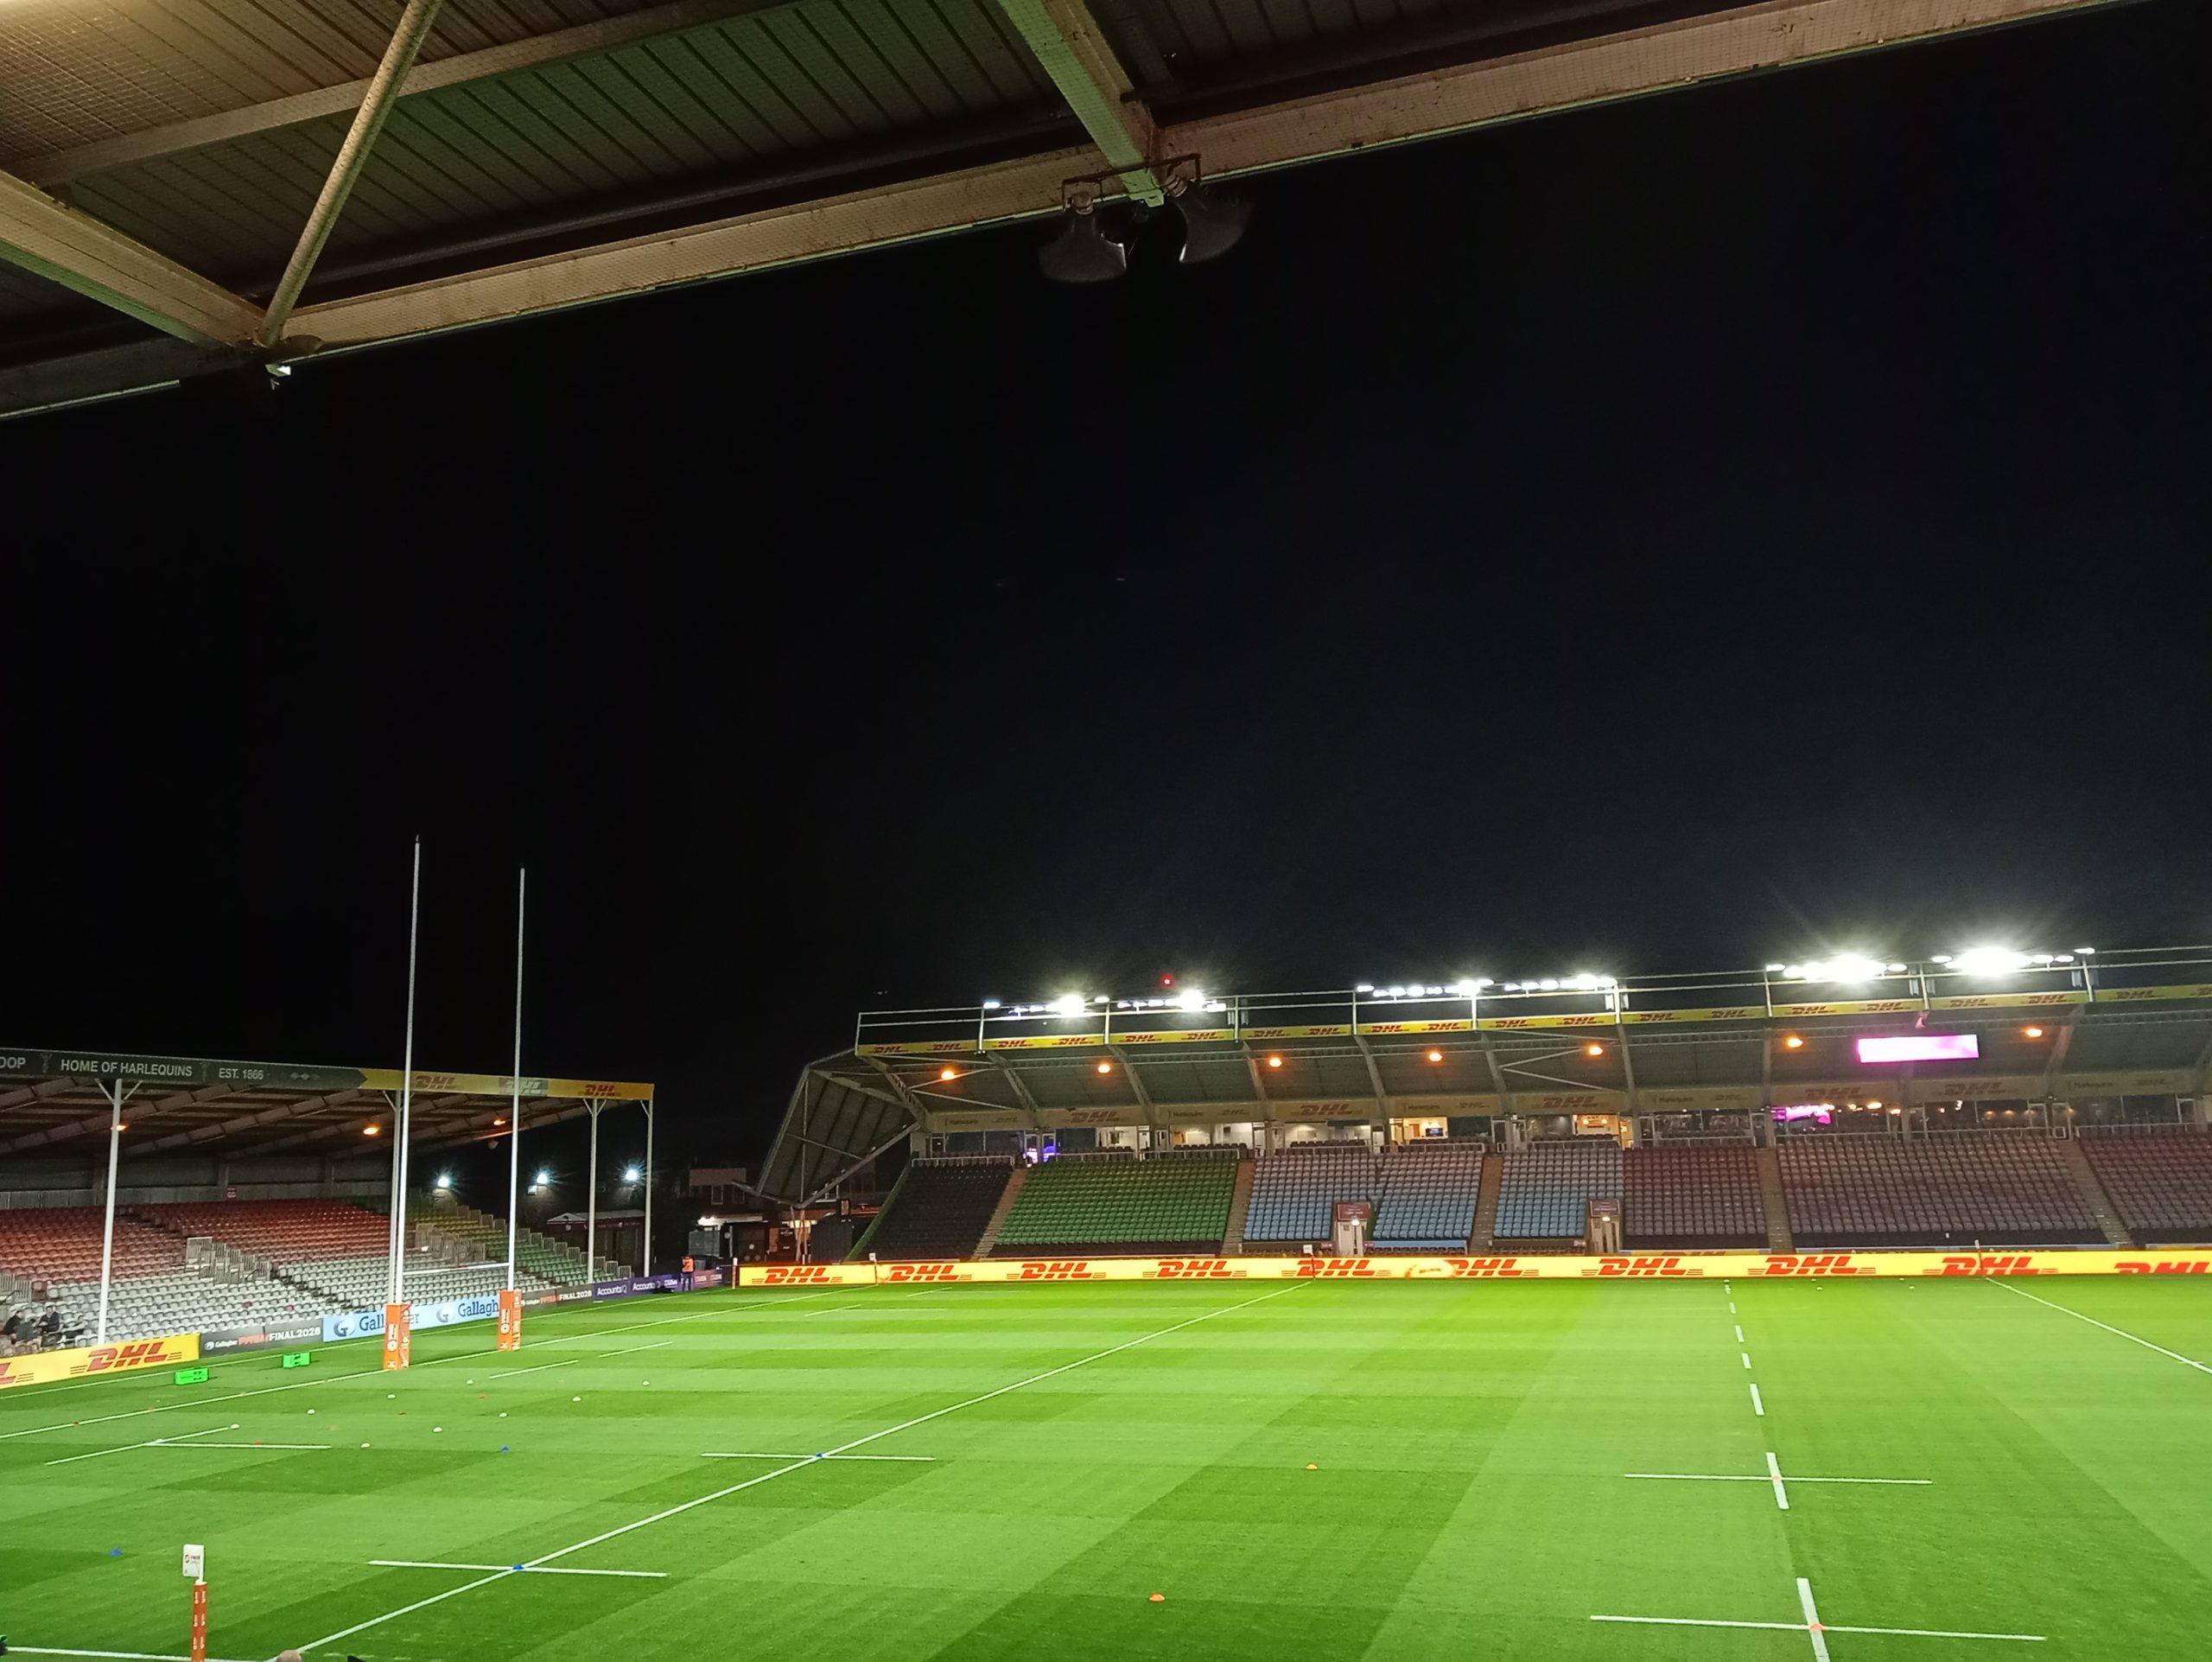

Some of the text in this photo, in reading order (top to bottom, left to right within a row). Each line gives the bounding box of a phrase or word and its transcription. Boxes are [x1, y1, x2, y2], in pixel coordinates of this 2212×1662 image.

[2028, 995, 2067, 1003] DHL
[2115, 990, 2155, 999] DHL
[1792, 1005, 1828, 1014] DHL
[1950, 998, 1988, 1007] DHL
[1563, 1016, 1597, 1025] DHL
[1639, 1013, 1675, 1022] DHL
[1711, 1009, 1747, 1018] DHL
[60, 1059, 192, 1077] HOME OF HARLEQUINS
[219, 1068, 264, 1080] EST. 1866
[416, 1075, 456, 1090] DHL
[1944, 1082, 2005, 1095] DHL
[585, 1083, 615, 1097] DHL
[1805, 1086, 1864, 1099] DHL
[1542, 1096, 1599, 1108] DHL
[1300, 1104, 1352, 1115] DHL
[1070, 1111, 1120, 1124] DHL
[1020, 1263, 1092, 1279] DHL
[1156, 1261, 1232, 1277] DHL
[1296, 1259, 1376, 1276] DHL
[1443, 1259, 1523, 1277] DHL
[1599, 1258, 1687, 1276] DHL
[1765, 1256, 1858, 1275] DHL
[1942, 1257, 2040, 1275] DHL
[764, 1267, 830, 1283] DHL
[888, 1265, 959, 1282] DHL
[458, 1299, 499, 1316] Gallagh
[87, 1341, 168, 1371] DHL
